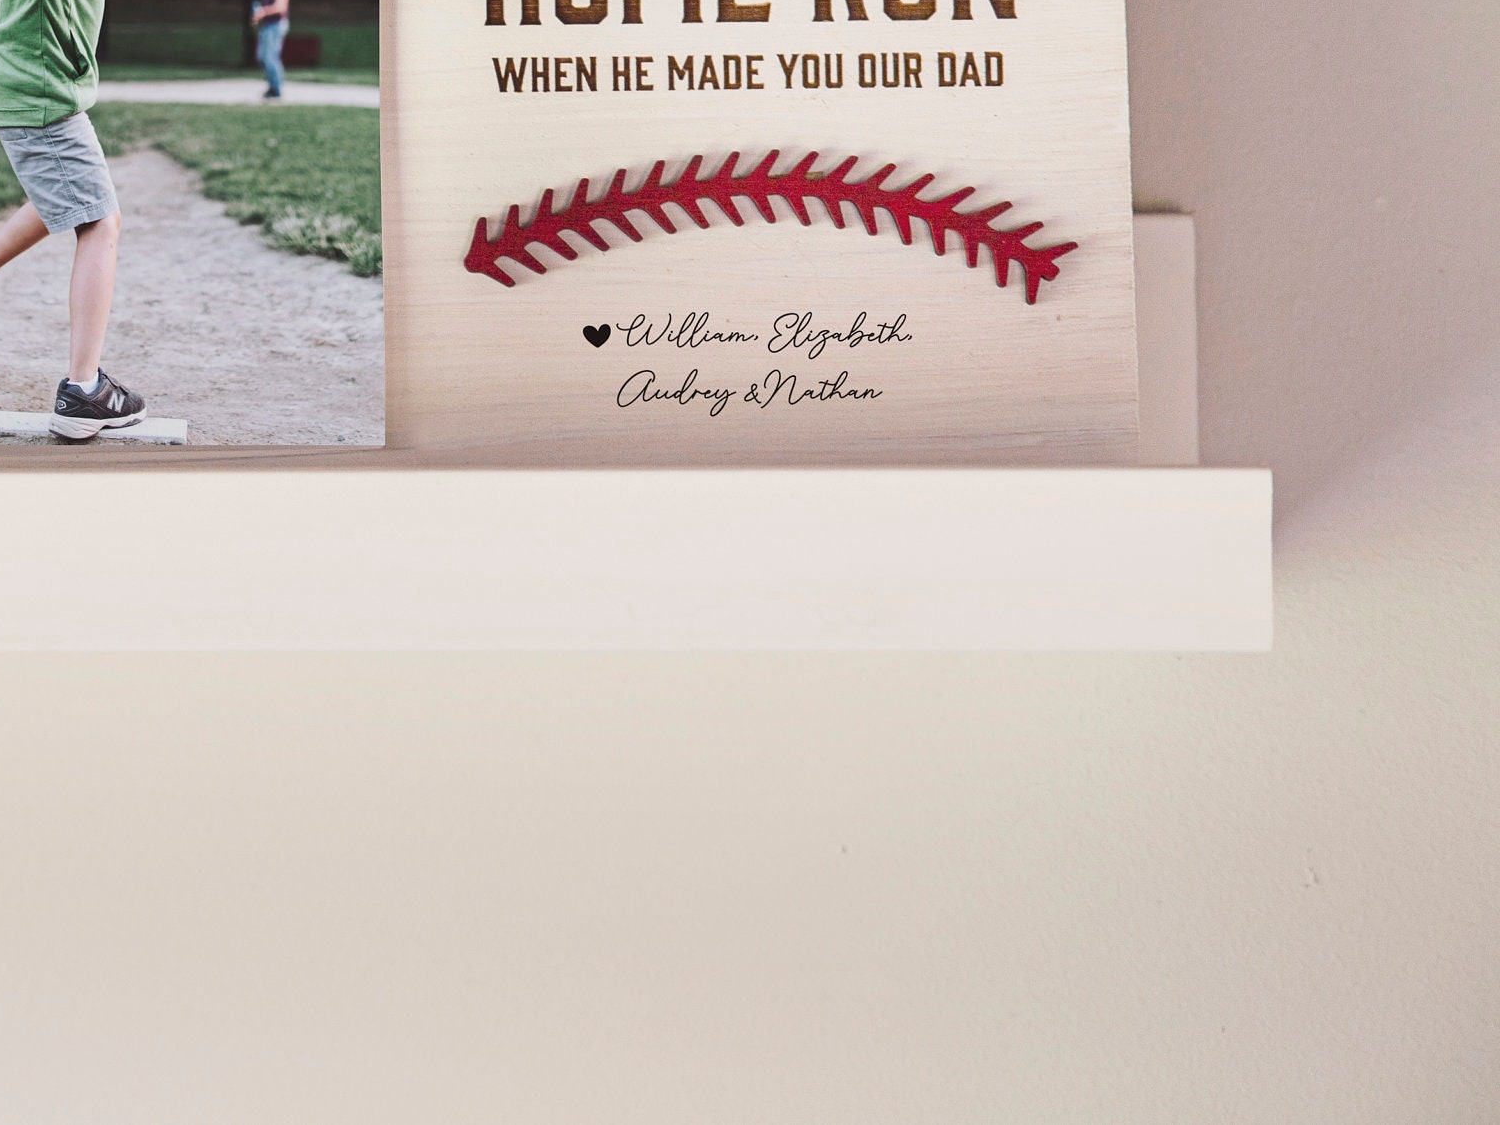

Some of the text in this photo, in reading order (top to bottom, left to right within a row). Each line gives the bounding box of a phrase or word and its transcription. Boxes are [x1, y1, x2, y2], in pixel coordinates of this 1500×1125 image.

[491, 51, 1005, 93] WHEN HE MADE YOU OUR DAD
[616, 368, 737, 418] Audrey
